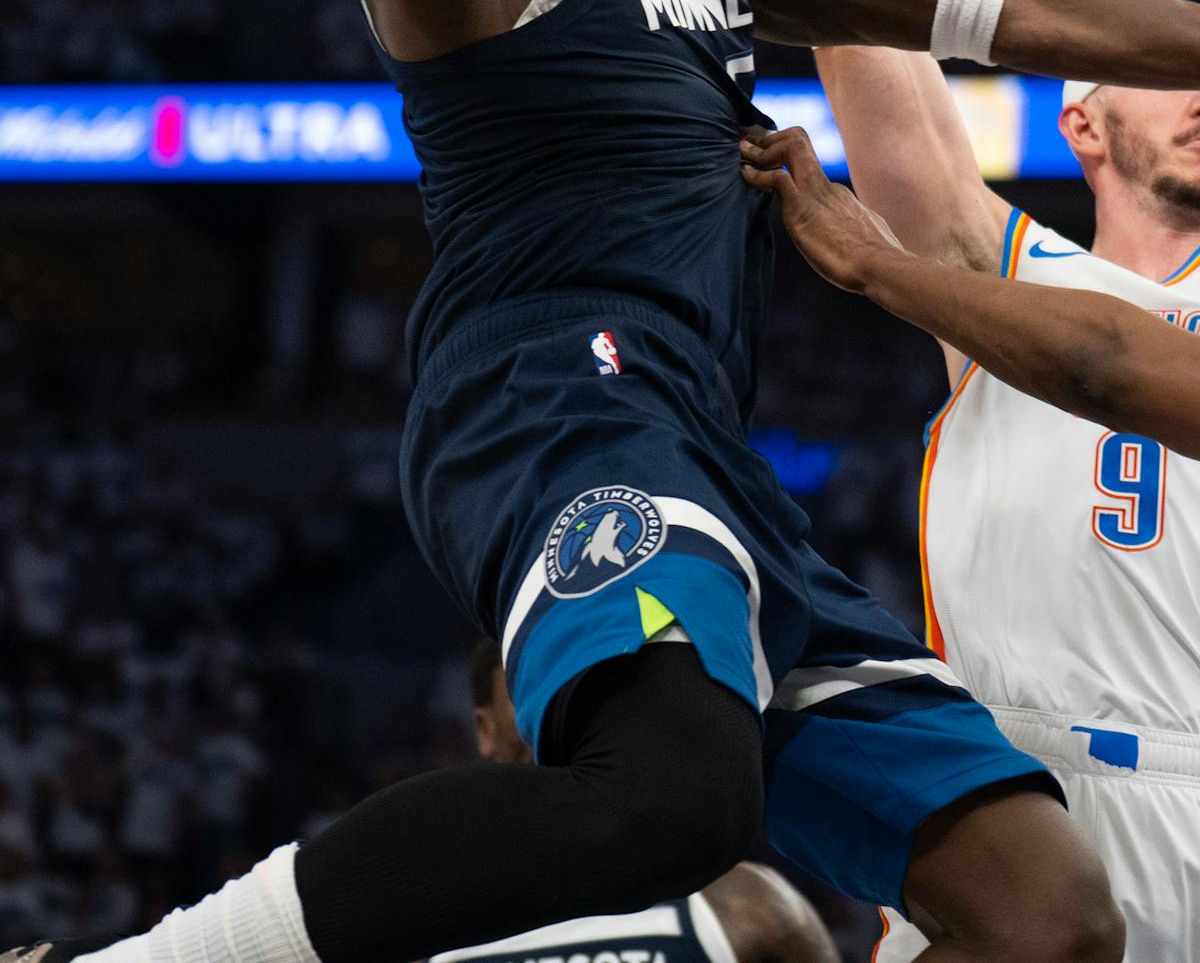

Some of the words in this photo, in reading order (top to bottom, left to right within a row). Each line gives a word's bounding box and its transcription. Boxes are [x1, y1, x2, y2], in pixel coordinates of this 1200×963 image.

[188, 101, 391, 164] ULTRA
[593, 489, 661, 557] TIMBERWOLVES
[1092, 430, 1168, 552] 9
